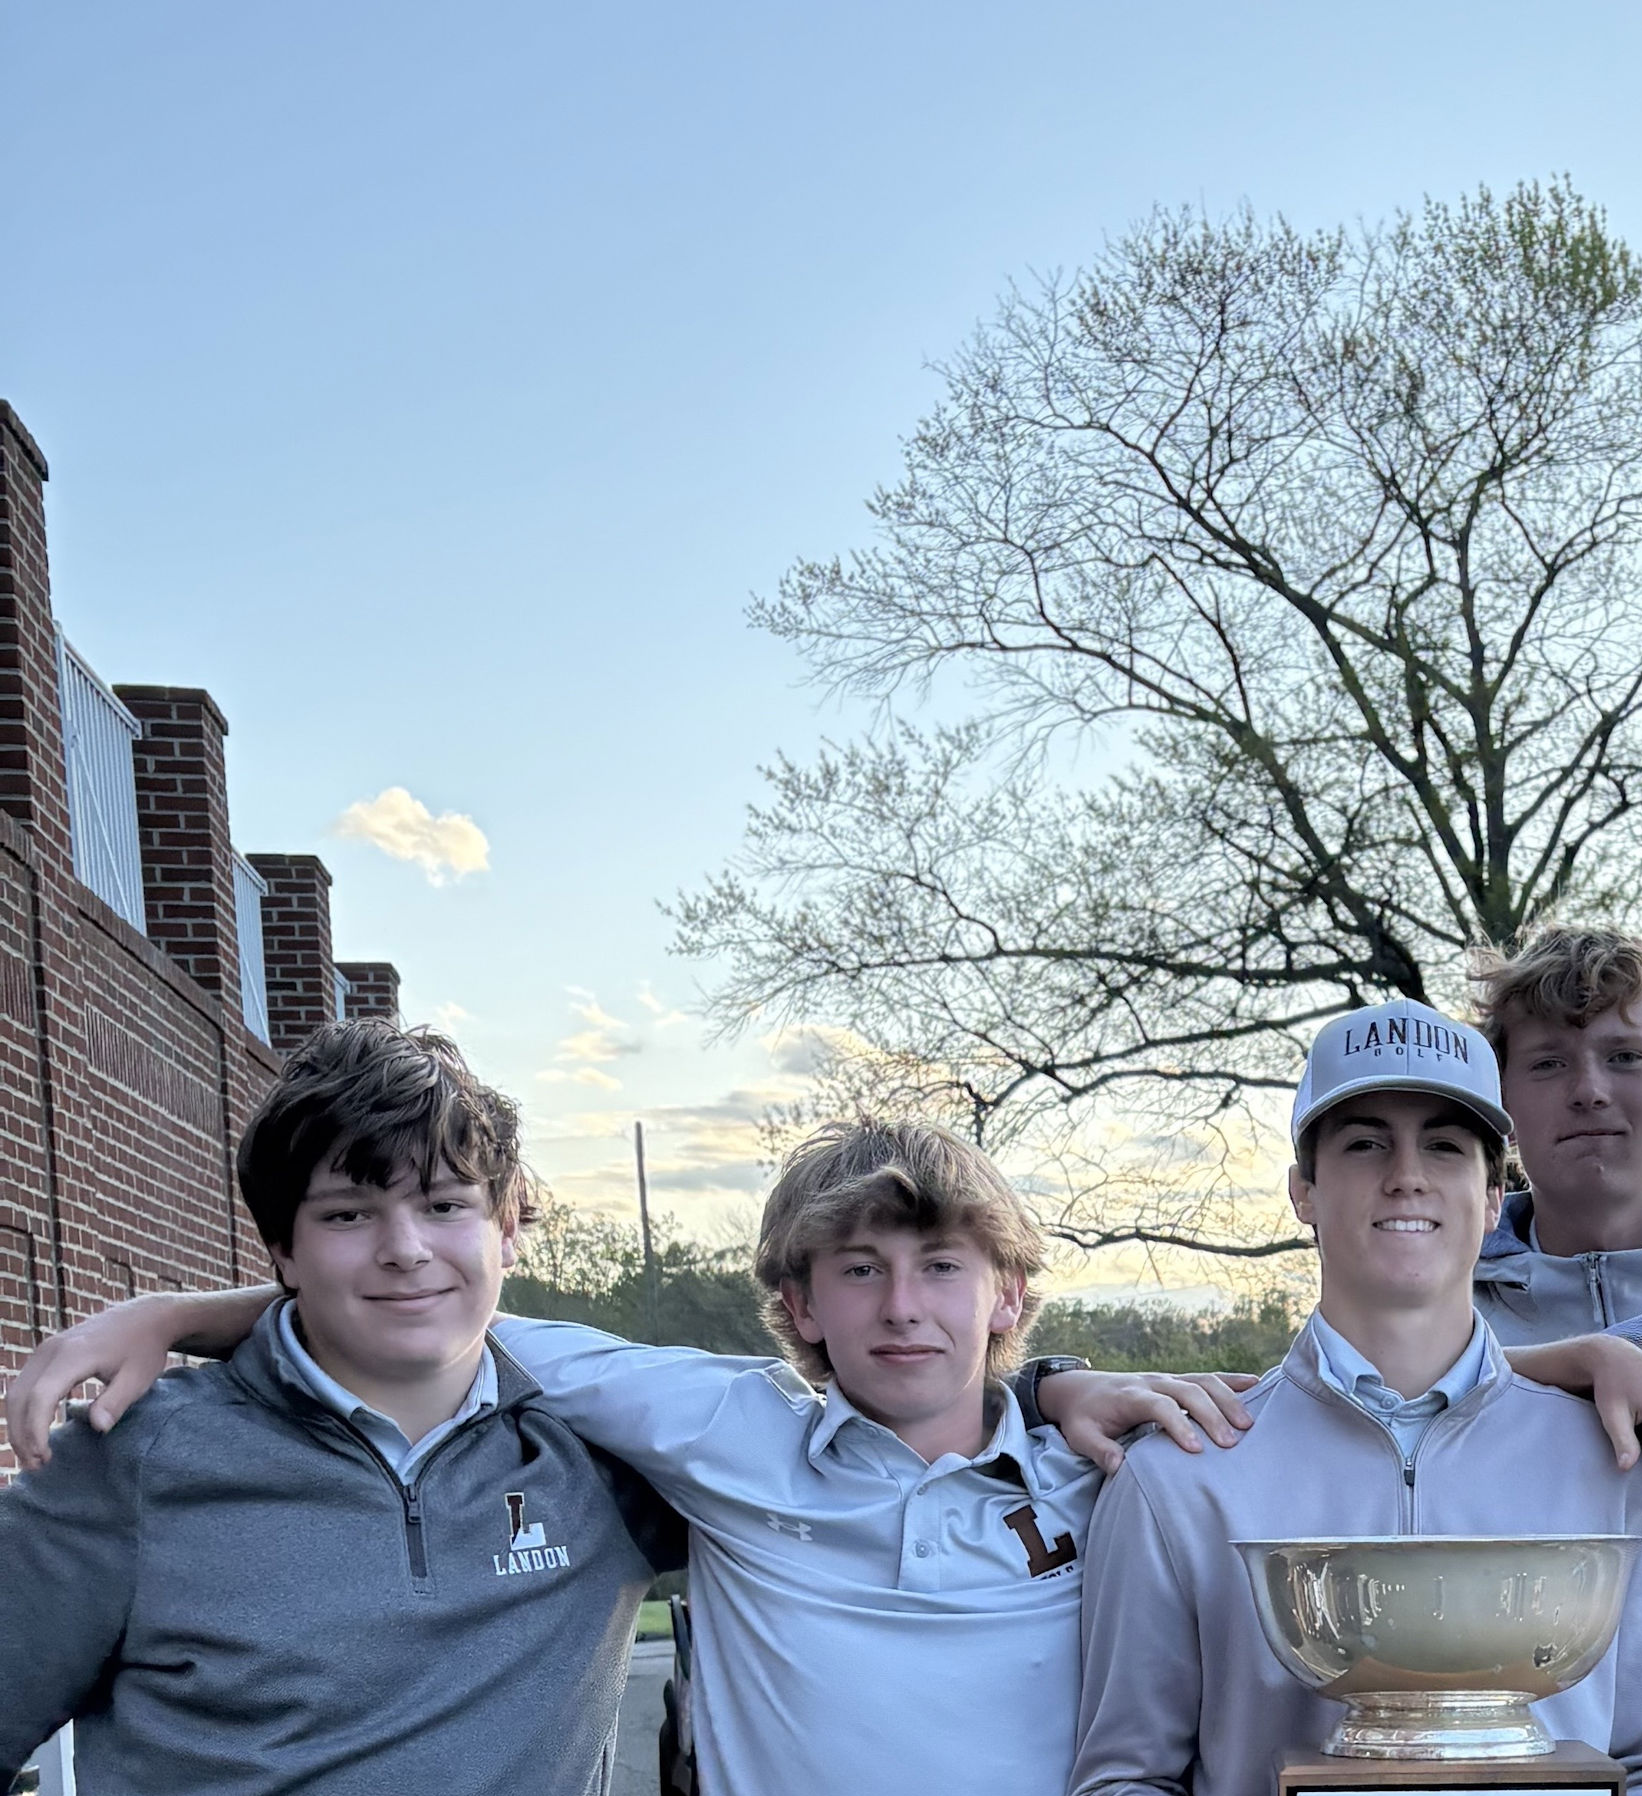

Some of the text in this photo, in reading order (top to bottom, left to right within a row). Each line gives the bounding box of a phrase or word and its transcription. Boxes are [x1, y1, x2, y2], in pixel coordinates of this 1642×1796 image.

[1344, 1016, 1469, 1065] LANDON
[1374, 1046, 1443, 1062] GOLF
[504, 1491, 547, 1551] L
[1002, 1504, 1078, 1578] L
[493, 1545, 571, 1576] LANDON
